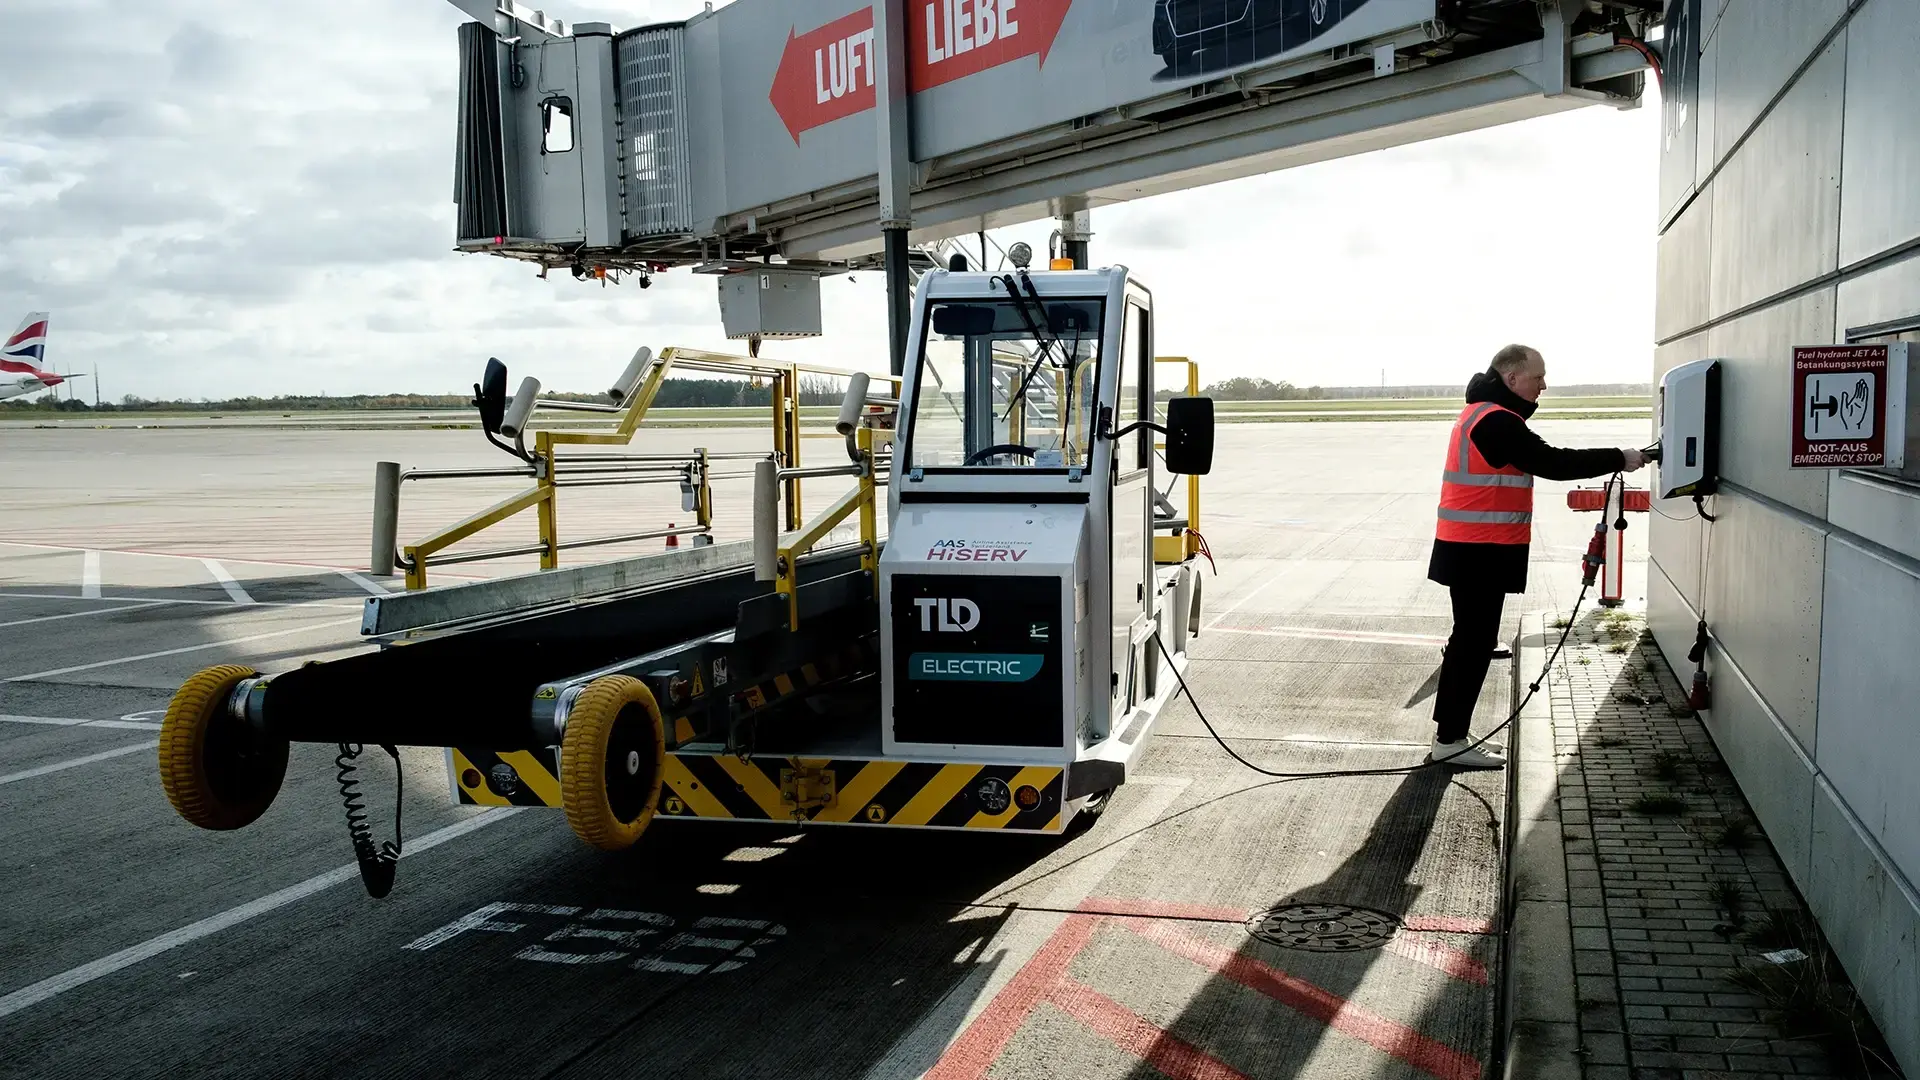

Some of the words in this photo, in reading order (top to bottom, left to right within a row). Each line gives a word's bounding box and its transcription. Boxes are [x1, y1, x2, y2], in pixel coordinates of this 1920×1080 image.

[815, 27, 875, 105] LUFT
[926, 0, 1019, 65] LIEBE
[1797, 351, 1816, 360] Fuel
[1817, 350, 1851, 360] hydrant
[1852, 349, 1870, 358] JET
[1871, 349, 1886, 357] A-1
[1797, 360, 1885, 369] Betankungssystem
[1808, 443, 1868, 453] NOT-AUS
[1856, 453, 1882, 462] STOP
[933, 539, 965, 548] AAS
[927, 548, 1028, 562] HiSERV
[914, 598, 980, 632] TLD
[923, 659, 1021, 675] ELECTRIC
